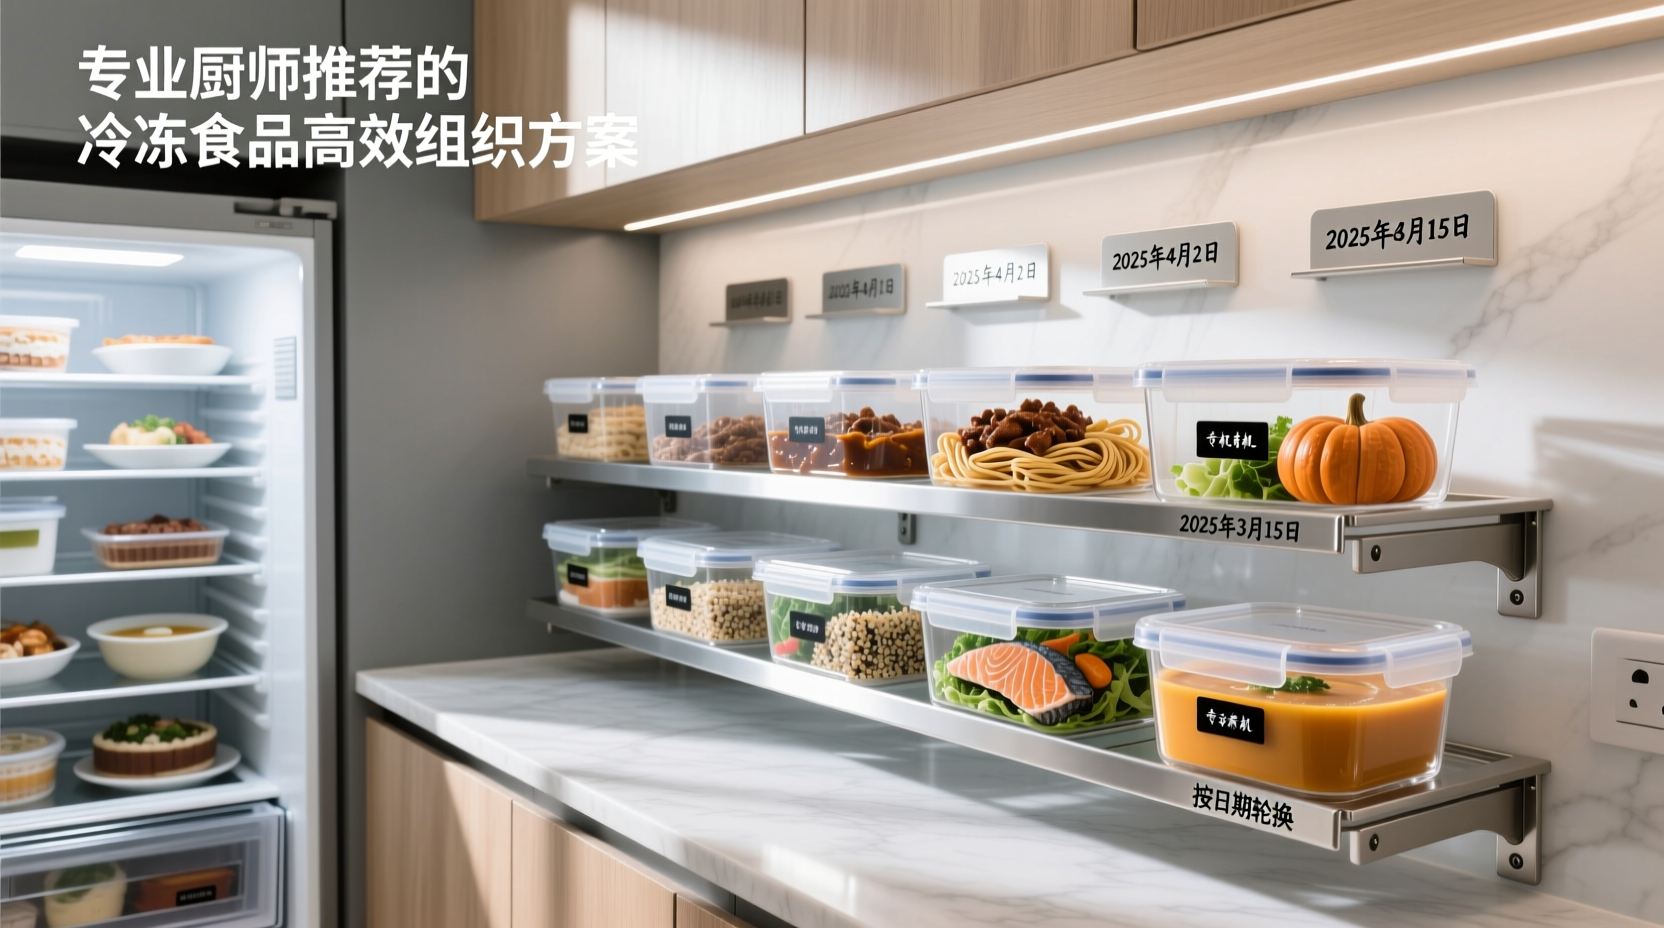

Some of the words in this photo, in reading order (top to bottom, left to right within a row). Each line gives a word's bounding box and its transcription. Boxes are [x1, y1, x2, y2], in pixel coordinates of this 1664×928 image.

[1112, 241, 1219, 271] 2025年4月2日
[952, 261, 1037, 287] 2025年4月2日
[1179, 513, 1300, 543] 2025年3月15日
[1192, 782, 1294, 832] 按日期轮换
